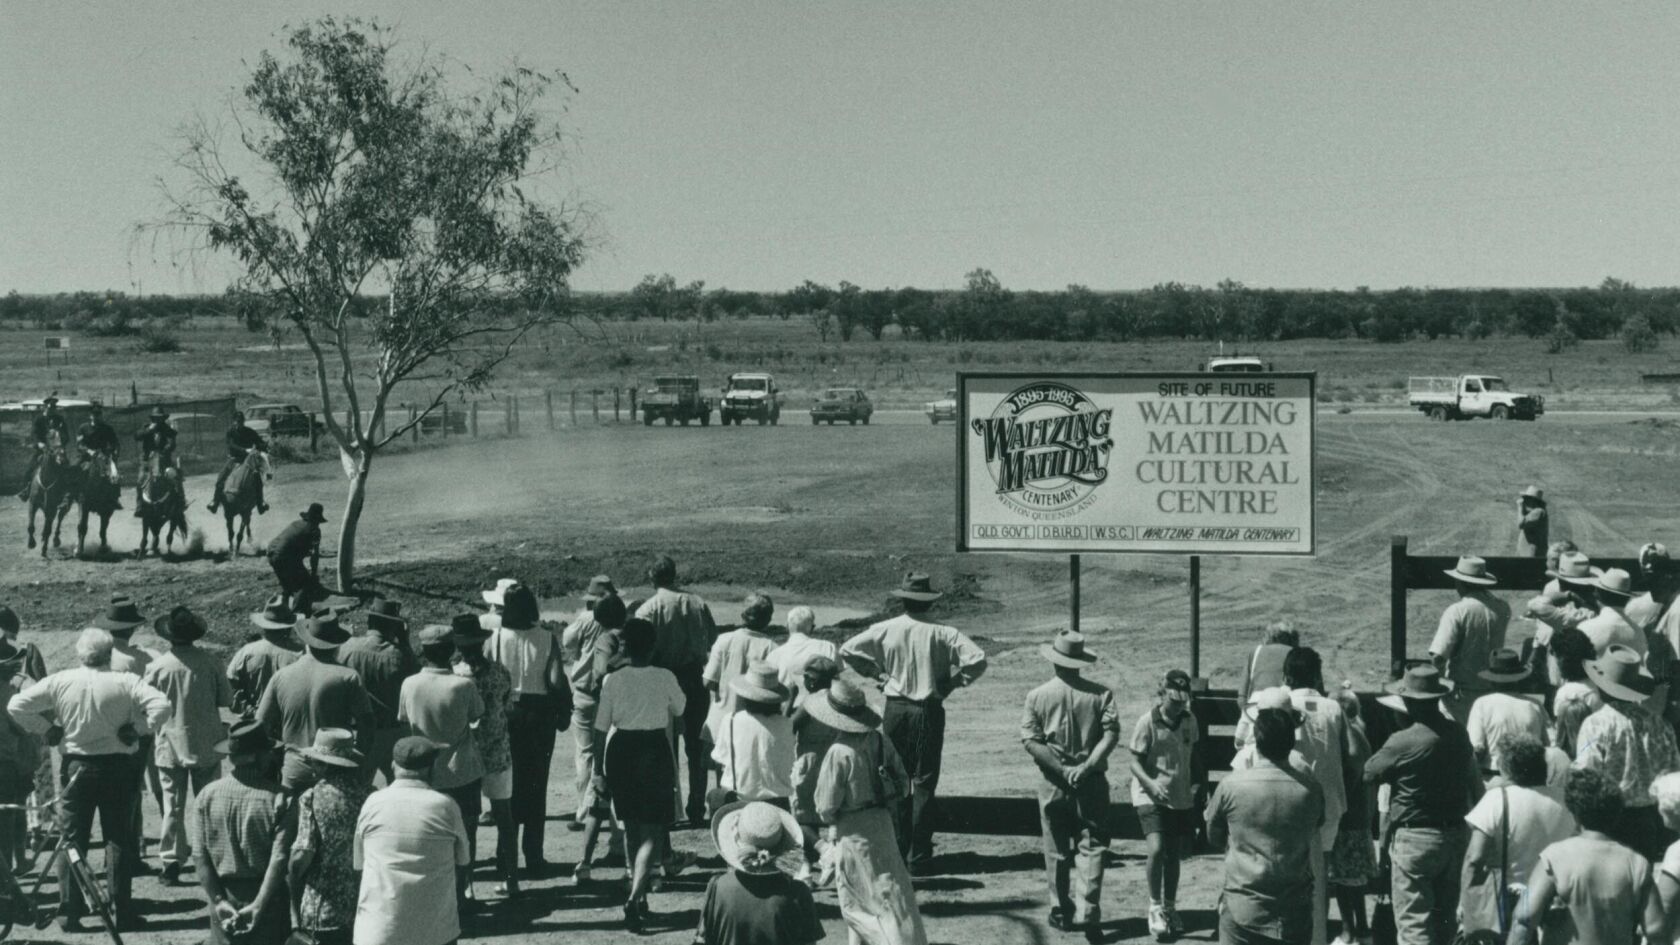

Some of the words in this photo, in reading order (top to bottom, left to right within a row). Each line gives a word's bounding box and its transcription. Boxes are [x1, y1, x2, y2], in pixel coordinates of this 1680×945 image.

[1012, 388, 1076, 408] 1895-1995
[1158, 382, 1189, 396] SITE
[1195, 382, 1213, 396] OF
[1220, 382, 1275, 397] FUTURE
[1137, 401, 1297, 425] WALTZING
[1146, 431, 1290, 454] MATILDA
[1136, 459, 1299, 485] CULTURAL
[1022, 484, 1079, 506] CENTENARY
[1156, 489, 1278, 515] CENTRE
[1032, 494, 1098, 521] QUEENSLAND
[1142, 527, 1194, 540] WALTZING
[1198, 528, 1239, 540] MATILDA
[1243, 528, 1295, 541] CENTENARY
